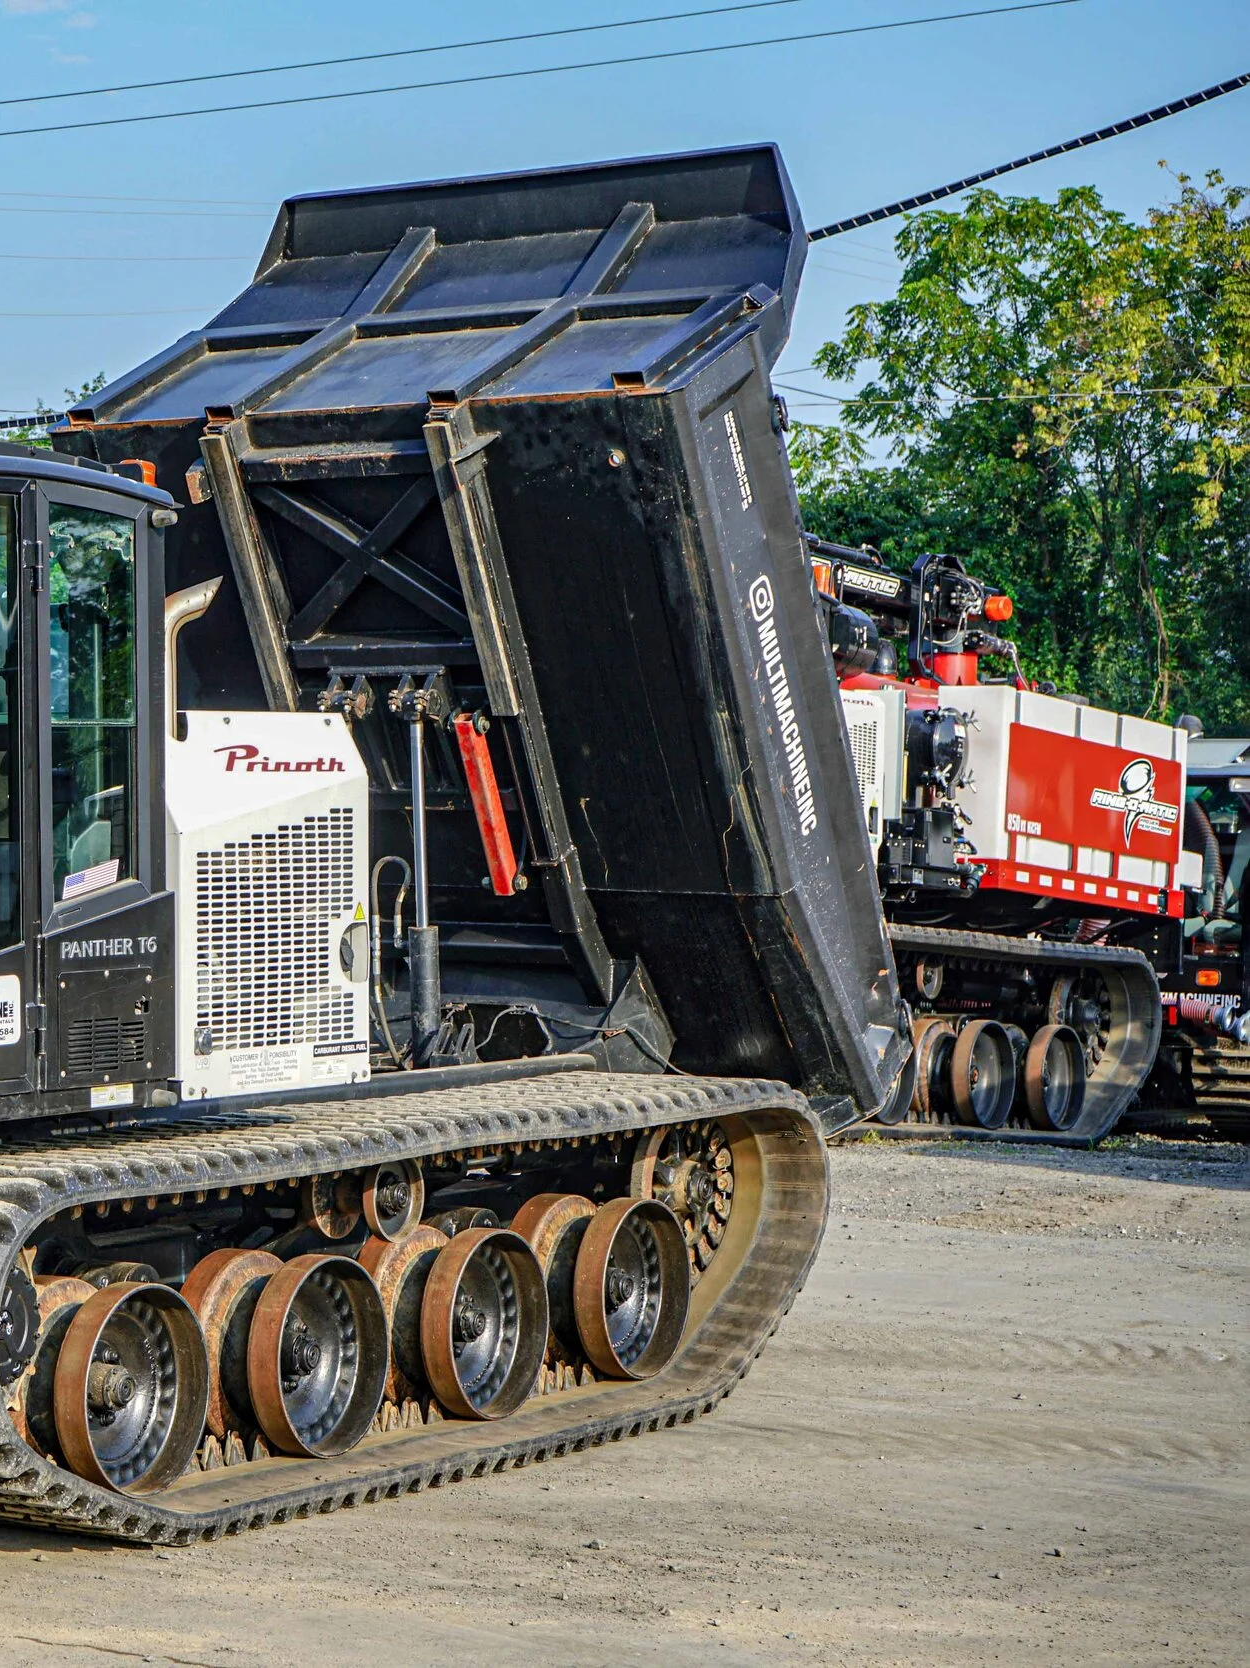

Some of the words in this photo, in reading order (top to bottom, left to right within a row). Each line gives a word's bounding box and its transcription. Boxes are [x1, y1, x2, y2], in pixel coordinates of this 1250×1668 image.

[757, 616, 818, 837] MULTIMACHINEINC
[213, 744, 346, 772] Prinoth
[61, 938, 134, 959] PANTHER
[138, 936, 158, 954] T6
[233, 1053, 259, 1063] CUSTOMER
